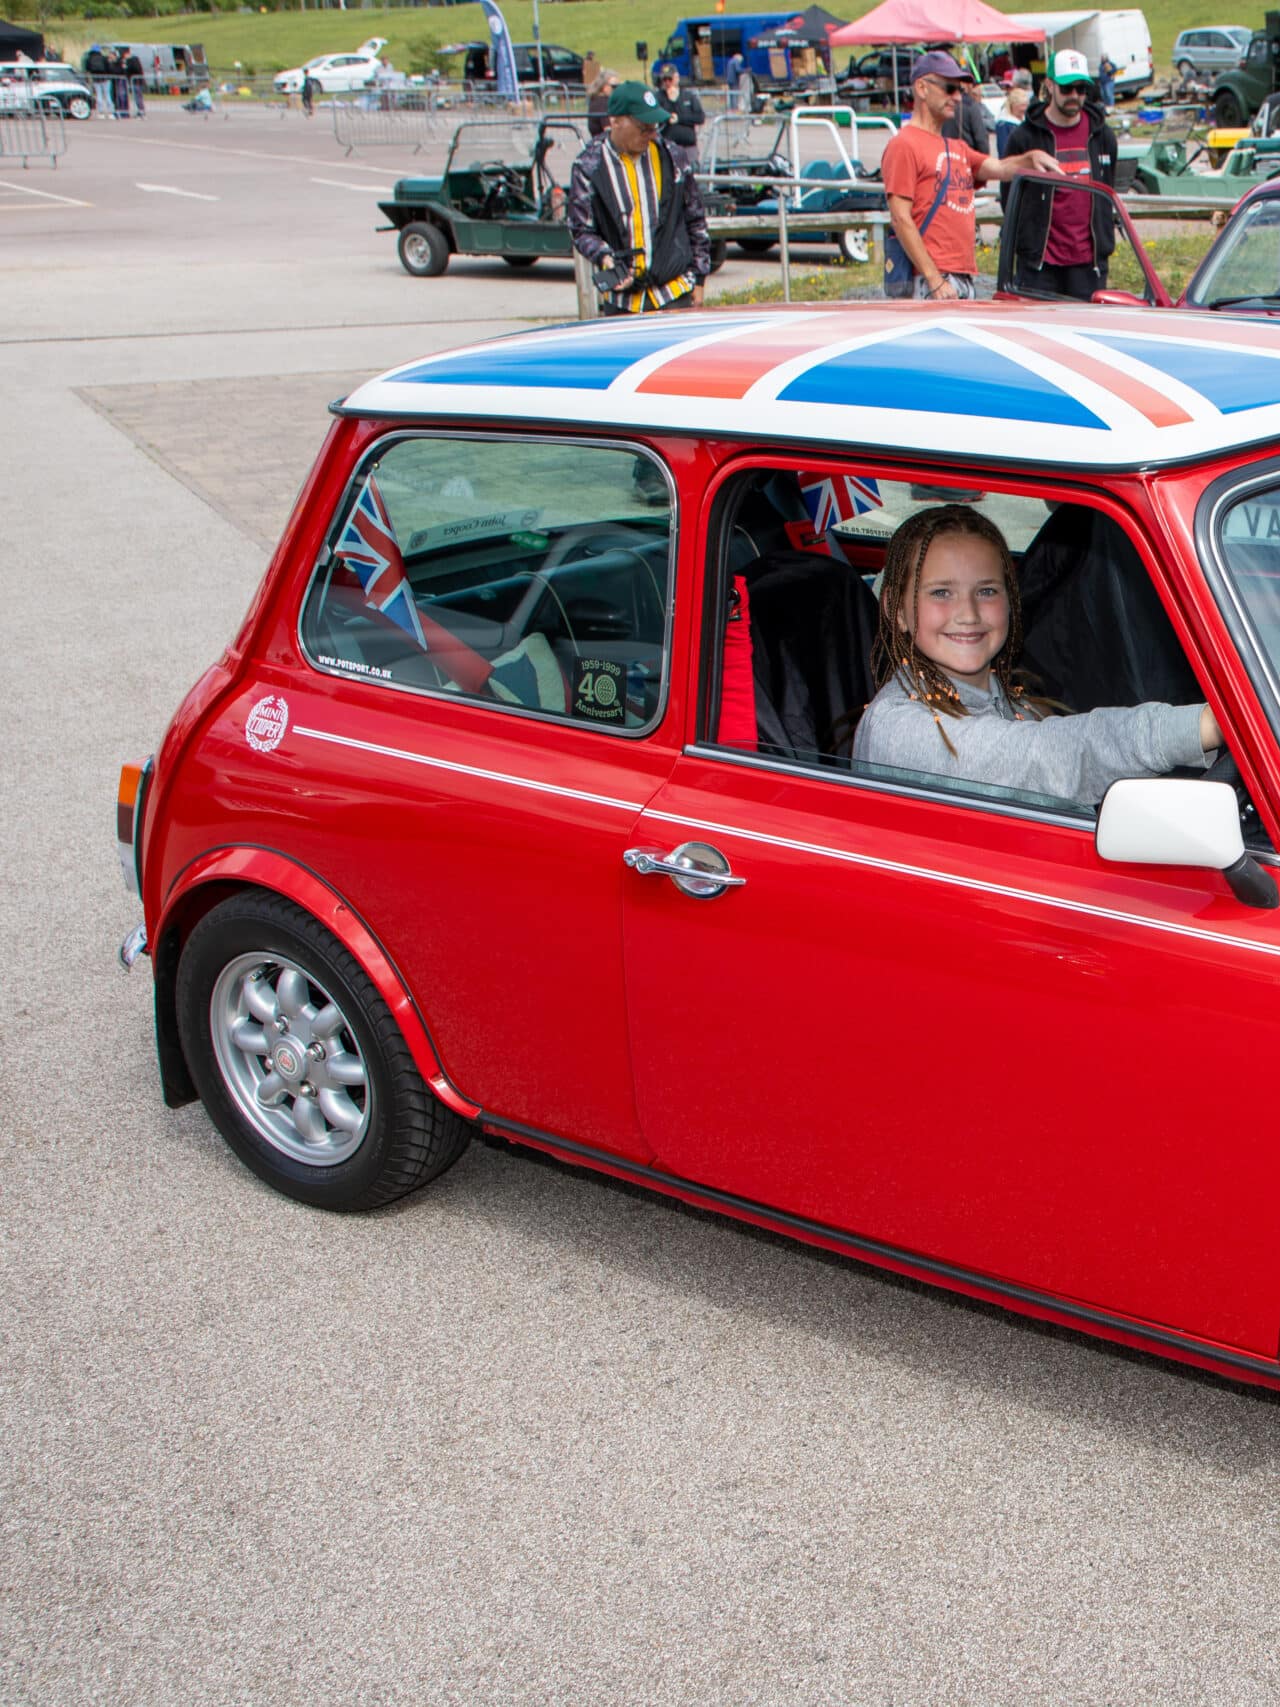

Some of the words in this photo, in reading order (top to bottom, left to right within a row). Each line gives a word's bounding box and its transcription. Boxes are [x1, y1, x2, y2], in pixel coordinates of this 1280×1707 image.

[318, 655, 392, 679] WWW.POTSPORT.CO.UK
[582, 659, 621, 676] 1959-1999
[257, 704, 283, 722] MINI
[575, 698, 624, 718] Anniversary
[250, 716, 282, 739] COOPER
